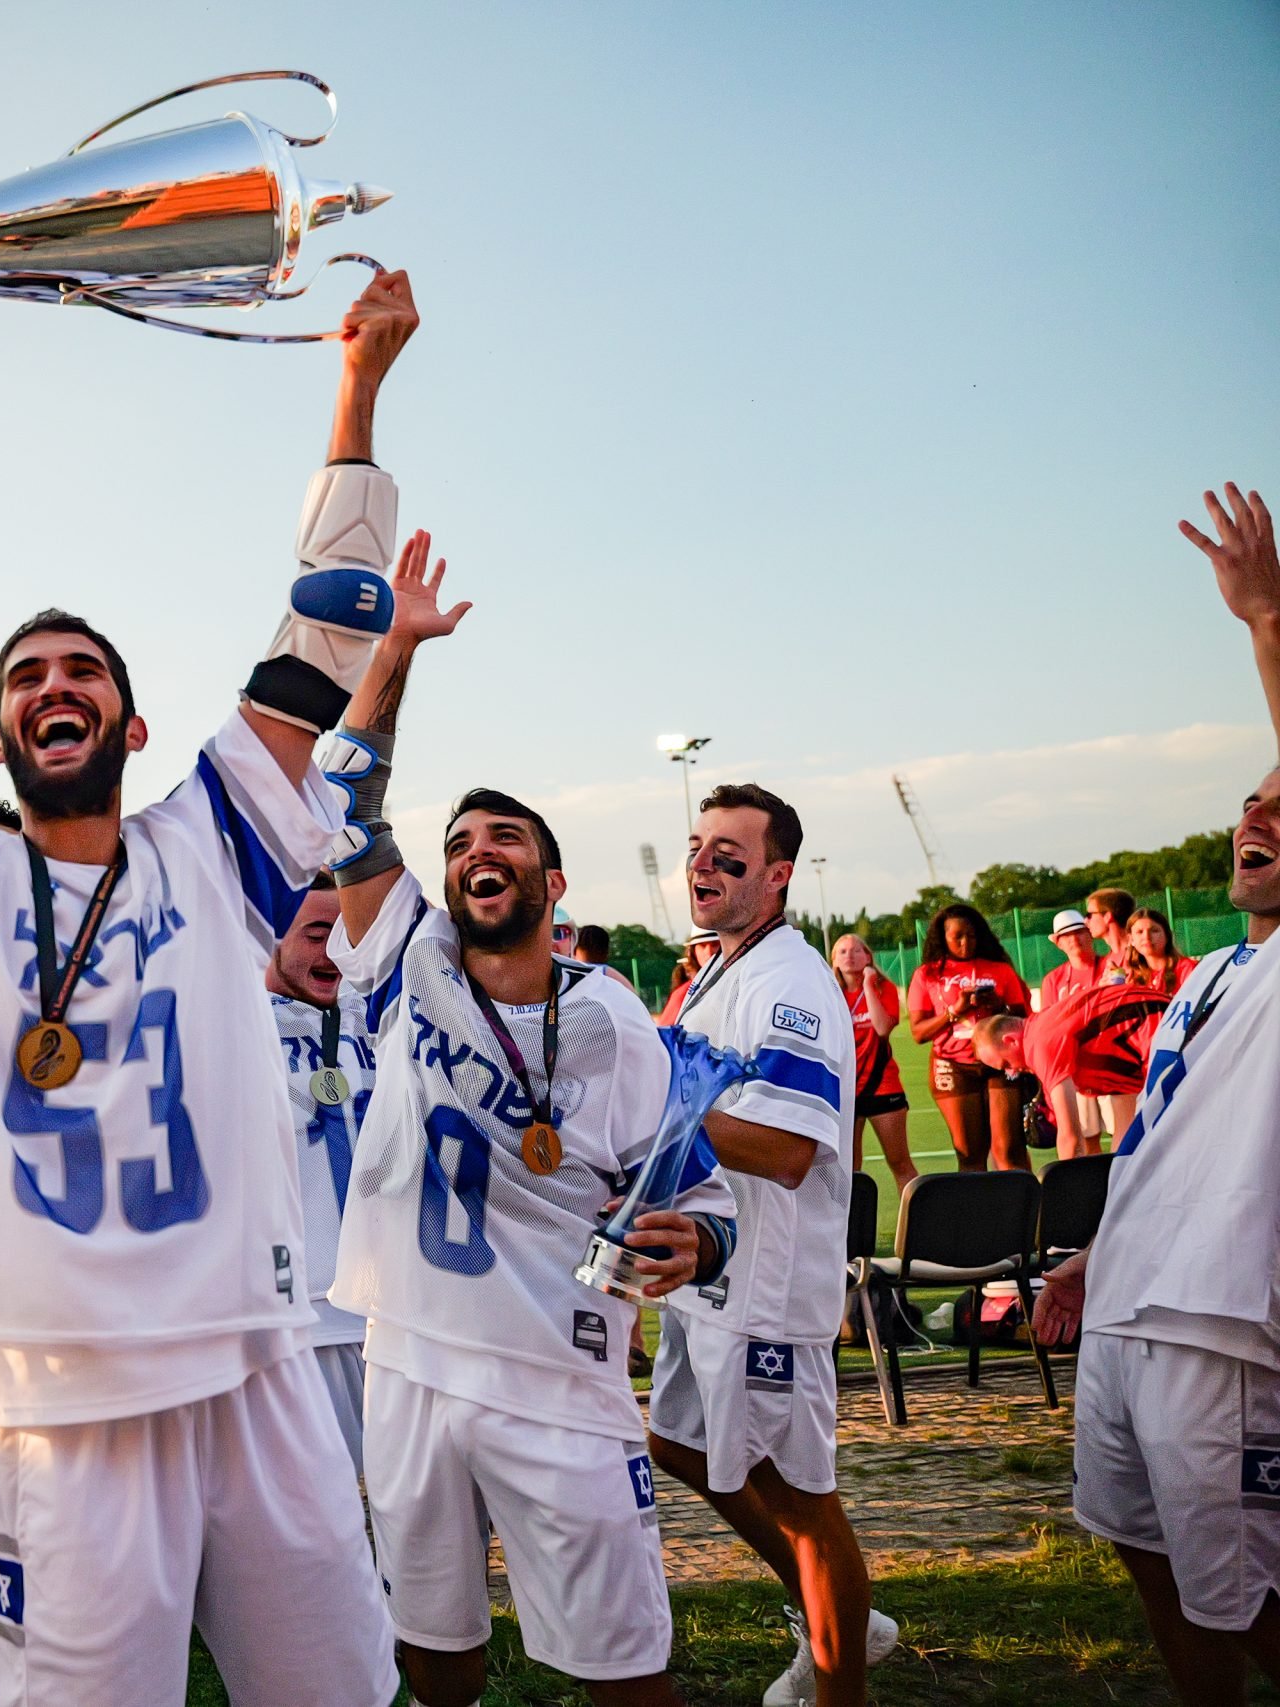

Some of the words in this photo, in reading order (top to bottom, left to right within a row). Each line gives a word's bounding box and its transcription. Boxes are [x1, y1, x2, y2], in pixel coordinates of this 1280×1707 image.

[2, 987, 212, 1235] 53
[418, 1104, 497, 1279] 0
[591, 1243, 601, 1270] 1
